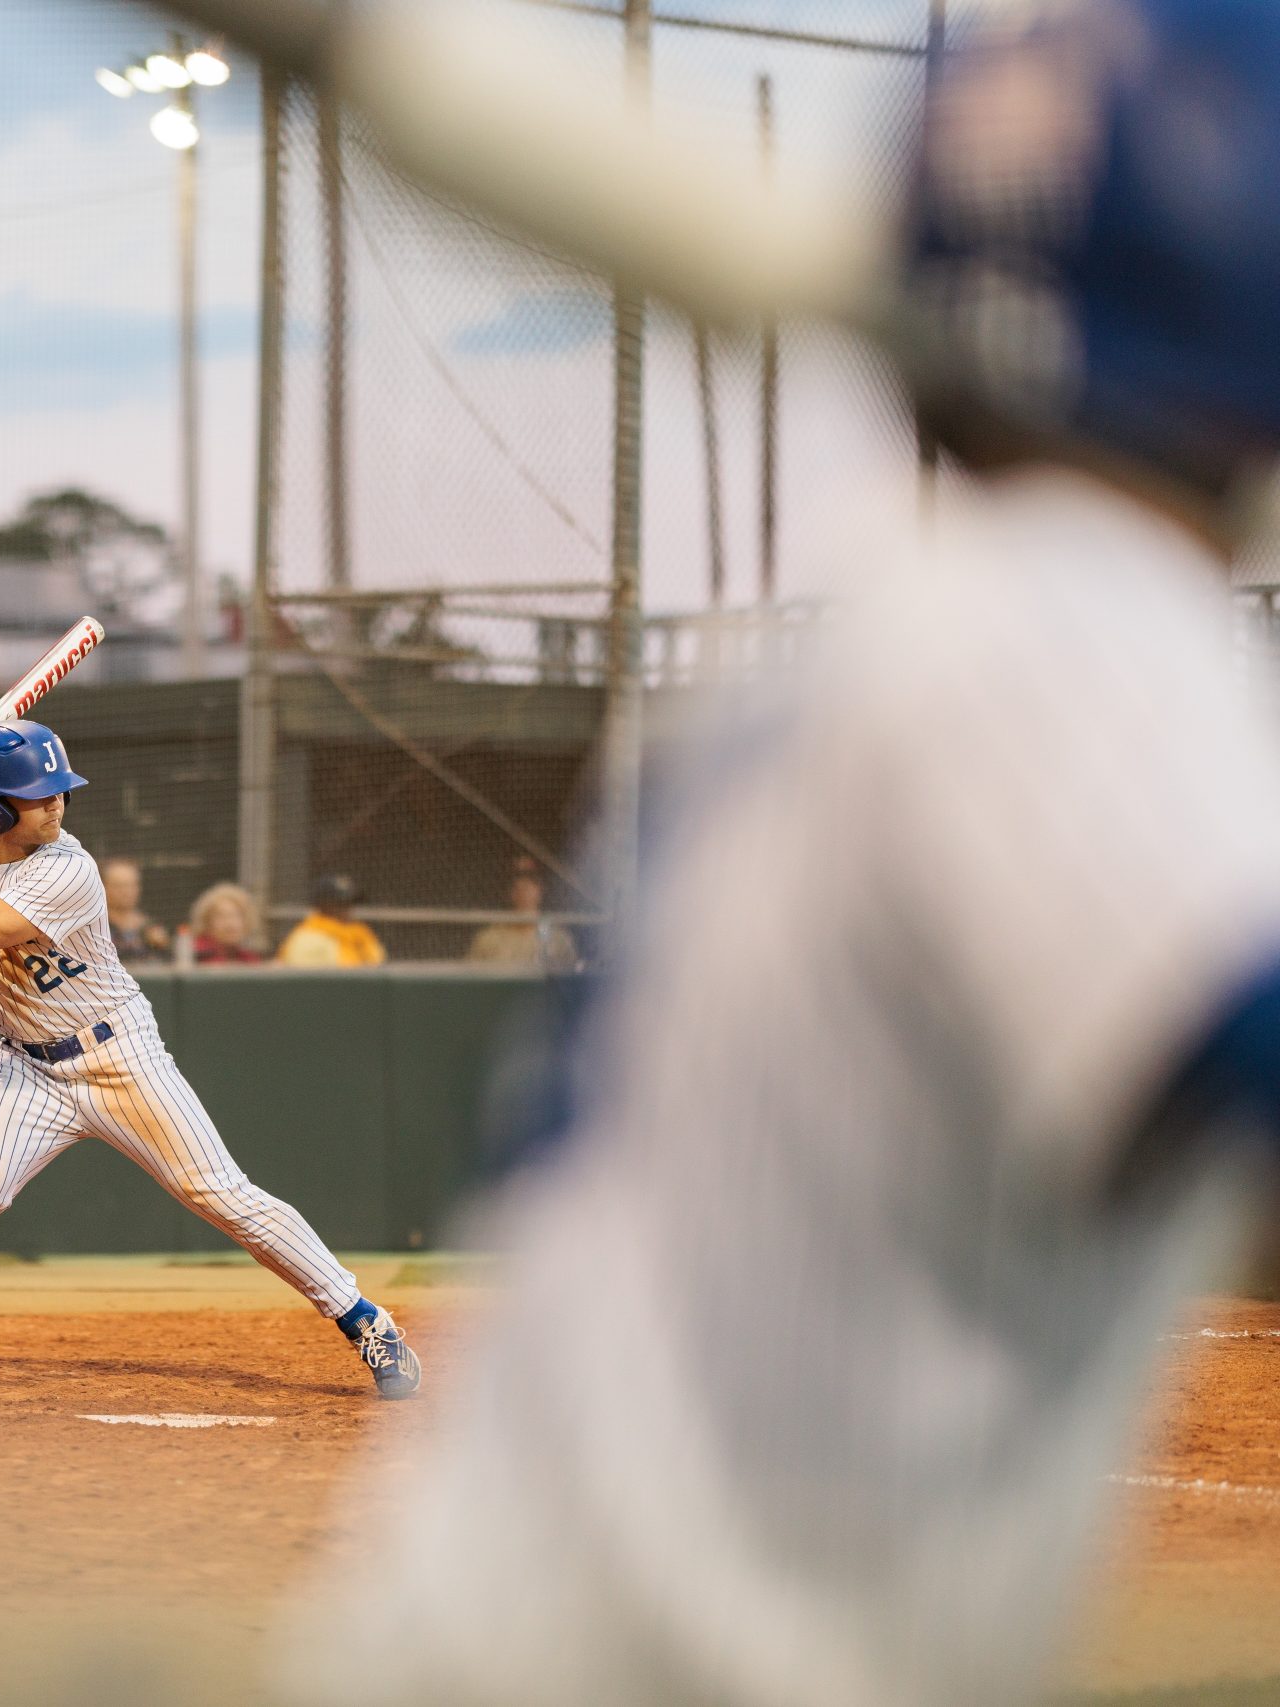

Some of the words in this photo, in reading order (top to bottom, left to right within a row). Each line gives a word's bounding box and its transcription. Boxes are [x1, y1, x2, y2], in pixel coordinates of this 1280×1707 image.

[13, 624, 98, 720] marucci
[43, 741, 58, 773] J
[24, 949, 88, 994] 22
